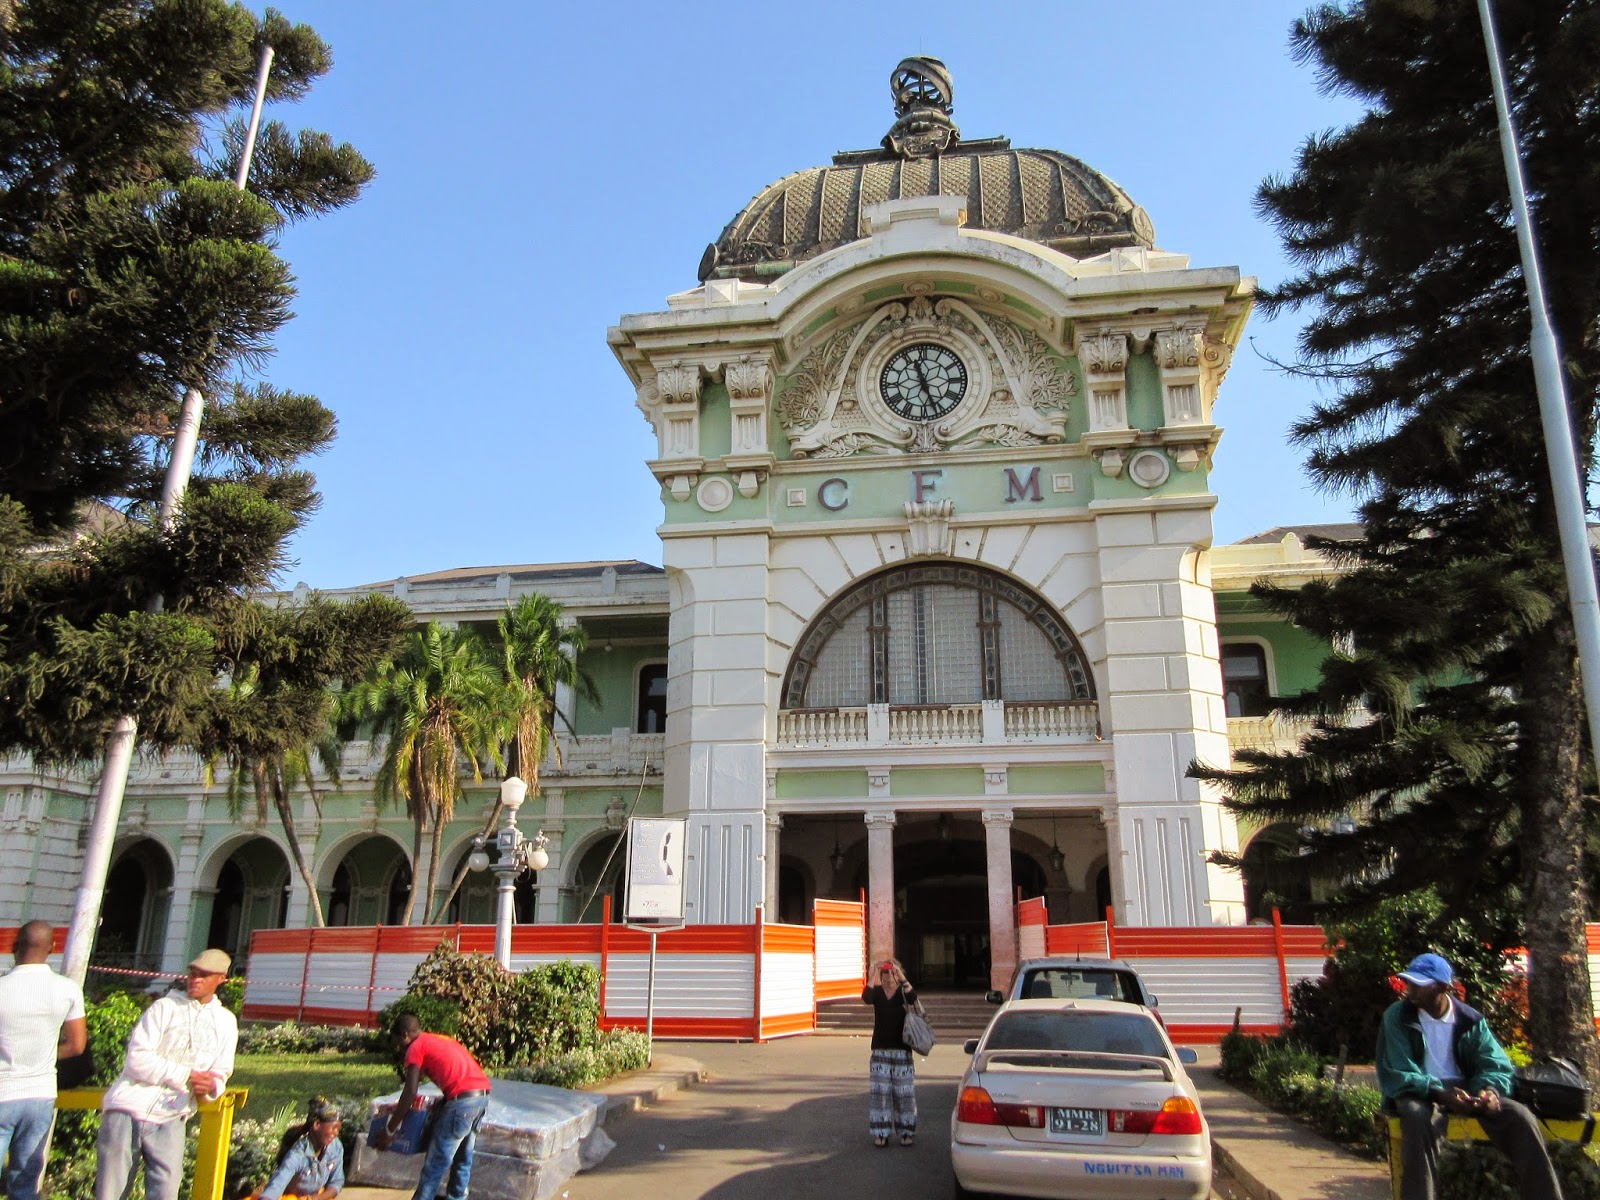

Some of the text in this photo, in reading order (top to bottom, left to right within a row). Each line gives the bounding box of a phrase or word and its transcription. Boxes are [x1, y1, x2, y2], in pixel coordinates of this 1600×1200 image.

[1057, 1108, 1094, 1119] MMR
[1054, 1119, 1099, 1132] 91-28
[1158, 1165, 1184, 1178] MAN
